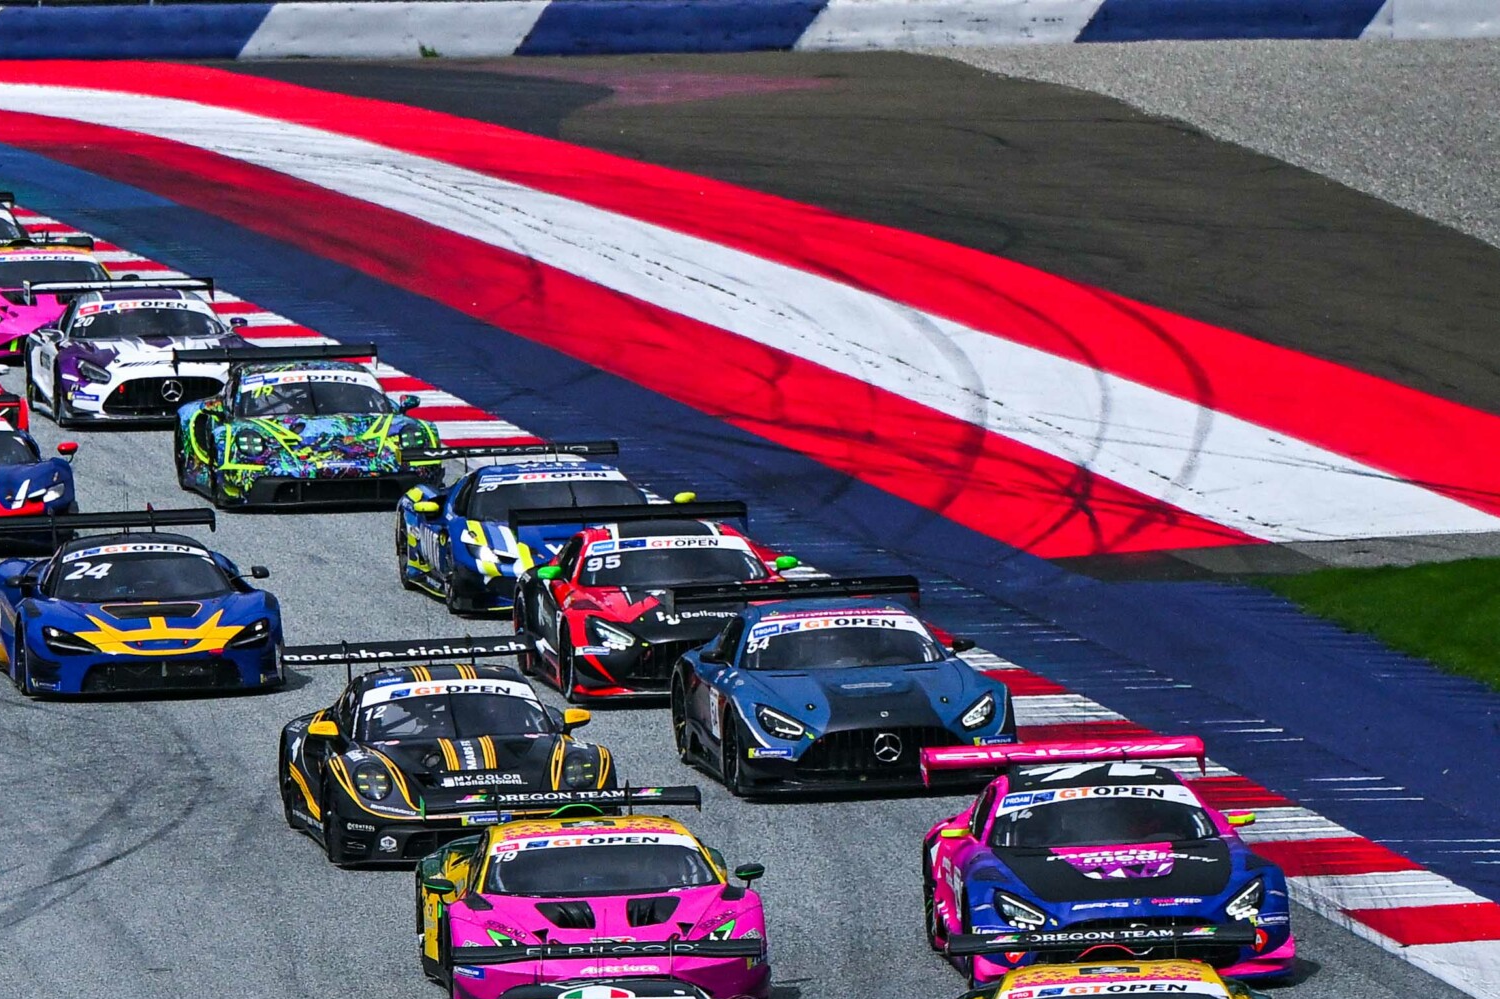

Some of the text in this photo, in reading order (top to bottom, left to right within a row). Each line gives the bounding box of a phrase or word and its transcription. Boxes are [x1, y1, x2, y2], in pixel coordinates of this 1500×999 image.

[75, 317, 94, 327] 20
[587, 555, 621, 571] 95
[65, 562, 112, 581] 24
[747, 637, 770, 654] 54
[364, 705, 385, 721] 12
[576, 789, 625, 798] TEAM
[1011, 808, 1032, 822] 14
[495, 851, 518, 864] 19
[1119, 929, 1175, 939] TEAM
[1011, 990, 1031, 999] PRO
